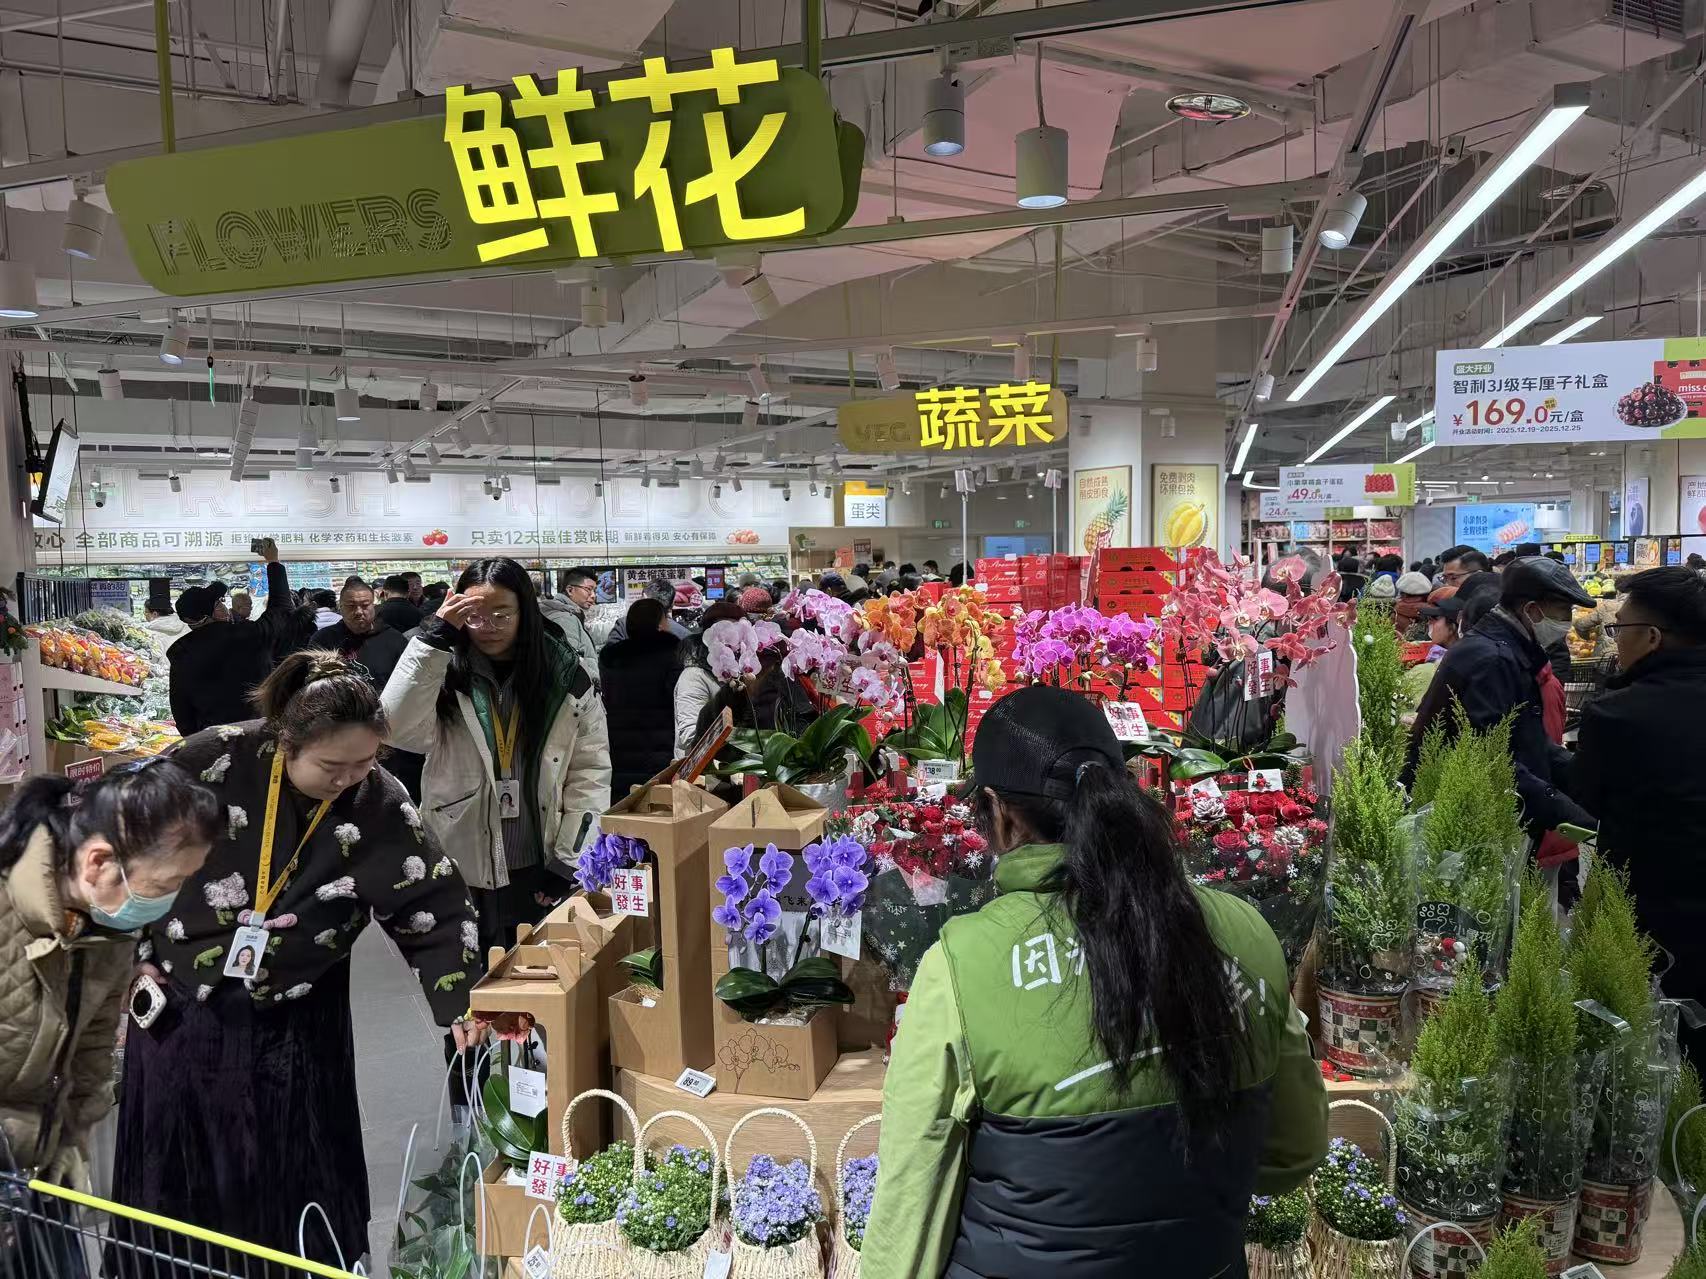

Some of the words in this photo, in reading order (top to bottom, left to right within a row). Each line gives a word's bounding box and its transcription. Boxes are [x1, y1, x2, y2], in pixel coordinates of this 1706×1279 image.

[444, 48, 805, 262] 鲜花
[151, 186, 453, 275] FLOWERS
[1455, 363, 1493, 374] 盛大开业
[1453, 373, 1609, 395] 智利3J级车厘子礼盒
[915, 380, 1055, 450] 蔬菜
[1079, 476, 1109, 489] 自然成熟
[1159, 472, 1196, 484] 免费剥肉
[1079, 487, 1109, 500] 削皮即食
[1159, 484, 1196, 495] 坏果包换
[850, 502, 880, 519] 蛋类
[76, 531, 224, 549] 全部商品可溯源
[309, 533, 414, 543] 化学农药和生长激素
[471, 530, 619, 545] 只卖12天最佳赏味期
[624, 531, 670, 542] 新鲜看得见
[673, 531, 717, 541] 安心有保障
[626, 568, 686, 580] 黄金榴莲蜜薯
[1248, 658, 1270, 676] 好事
[1108, 705, 1139, 720] 好事
[1114, 722, 1147, 737] 發生
[614, 874, 644, 891] 好事
[616, 894, 645, 912] 發生
